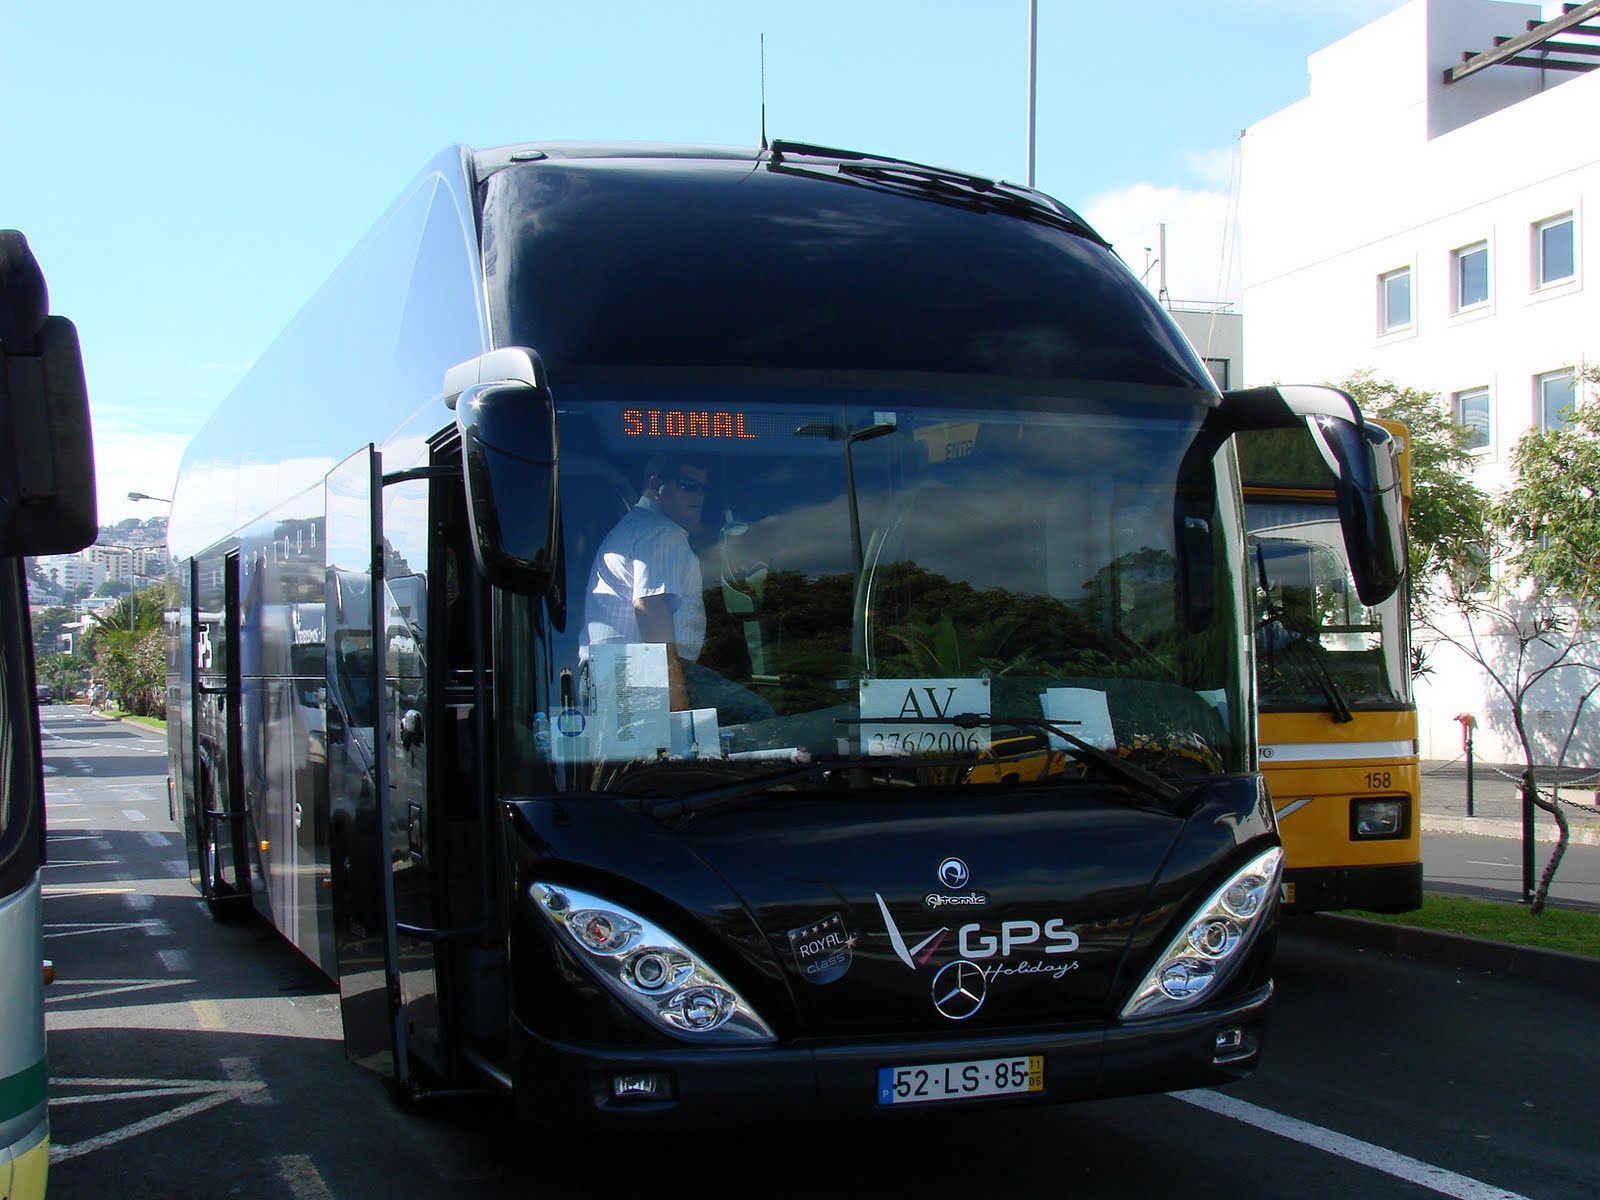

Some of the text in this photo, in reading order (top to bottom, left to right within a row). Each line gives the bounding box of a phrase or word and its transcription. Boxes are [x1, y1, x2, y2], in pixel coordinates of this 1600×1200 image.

[899, 687, 957, 719] AV
[873, 731, 980, 753] 376/2006
[1364, 772, 1392, 789] 158
[799, 932, 844, 958] ROYAL
[958, 918, 1079, 959] GPS
[806, 953, 846, 975] class
[962, 960, 1079, 983] Holidays
[882, 1089, 890, 1098] P
